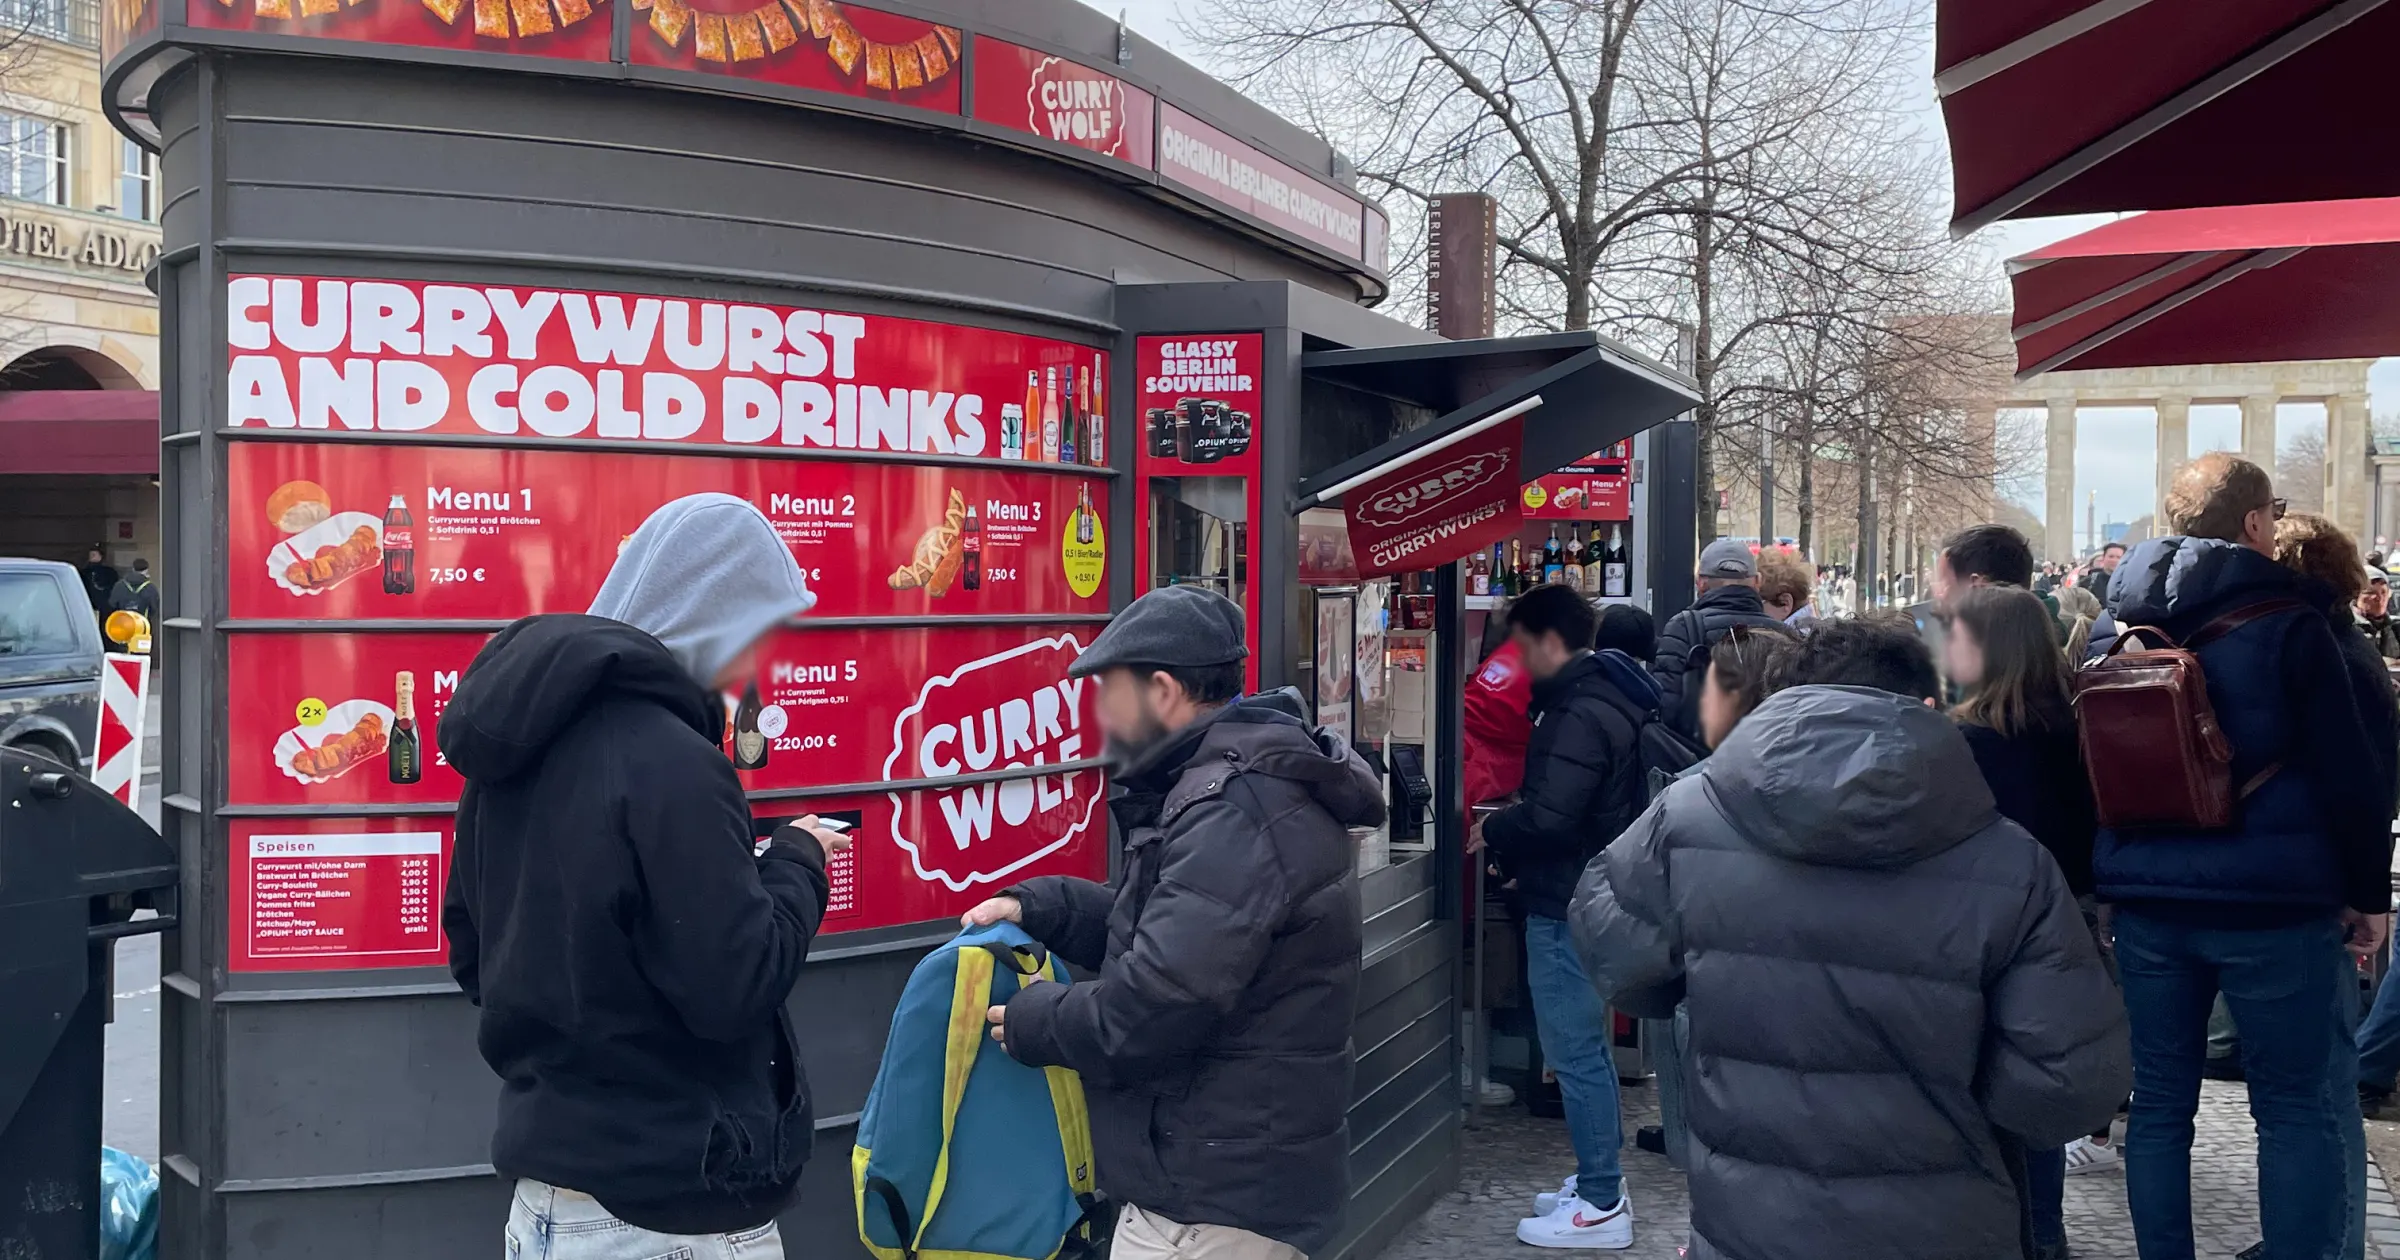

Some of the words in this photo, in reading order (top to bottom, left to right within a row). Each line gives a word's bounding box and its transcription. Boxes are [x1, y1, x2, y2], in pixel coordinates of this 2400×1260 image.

[1041, 80, 1114, 110] CURRY
[1048, 109, 1112, 141] WOLF
[1162, 125, 1230, 184] ORIGINAL
[1230, 156, 1290, 214] BERLINER
[1289, 187, 1362, 246] CURRYWURST
[1429, 199, 1441, 280] BERLINER
[228, 275, 865, 381] CURRYWURST
[1161, 341, 1238, 358] GLASSY
[1161, 358, 1237, 375] BERLIN
[1145, 375, 1253, 393] SOUVENIR
[228, 354, 450, 431] AND
[467, 363, 705, 445] COLD
[722, 375, 987, 457] DRINKS
[1373, 459, 1486, 513] CURRY
[1591, 480, 1614, 488] Menu
[1615, 480, 1622, 488] 4
[427, 487, 510, 511] Menu
[521, 488, 532, 511] 1
[770, 493, 834, 516] Menu
[841, 494, 855, 516] 2
[986, 500, 1028, 520] Menu
[1032, 501, 1041, 521] 3
[428, 516, 478, 526] Currywurst
[480, 516, 498, 525] und
[500, 516, 541, 525] Brötchen
[771, 519, 810, 529] Currywurst
[811, 520, 824, 528] mit
[824, 520, 854, 529] Pommes
[436, 525, 478, 534] Softdrink
[479, 526, 495, 536] 0,5
[810, 530, 823, 538] 0,5
[1372, 503, 1506, 568] CURRYWURST
[1369, 523, 1435, 554] ORIGINAL
[429, 567, 468, 584] 7,50
[472, 567, 486, 582] €
[987, 568, 1008, 583] 7,50
[1009, 568, 1016, 581] €
[771, 661, 837, 684] Menu
[844, 660, 858, 682] 5
[786, 688, 826, 698] Currywurst
[779, 699, 797, 707] Dom
[919, 677, 1085, 792] CURRY
[773, 735, 824, 752] 220,00
[827, 734, 838, 748] €
[938, 733, 1083, 851] WOLF
[257, 841, 316, 854] Speisen
[256, 862, 303, 872] Currywurst
[304, 861, 342, 871] mit/ohne
[343, 861, 367, 870] Darm
[401, 869, 420, 877] 4,00
[256, 872, 298, 881] Bratwurst
[298, 872, 310, 880] im
[311, 871, 349, 880] Brötchen
[256, 881, 318, 891] Curry-Boulette
[256, 891, 288, 901] Vegane
[289, 890, 351, 900] Curry-Bällchen
[256, 901, 293, 909] Pommes
[293, 899, 316, 908] frites
[401, 907, 420, 915] 0,20
[256, 910, 295, 919] Brötchen
[401, 916, 420, 924] 0,20
[256, 918, 317, 929] Ketchup/Mayo
[404, 925, 428, 935] gratis
[294, 928, 313, 937] HOT
[314, 927, 345, 936] SAUCE
